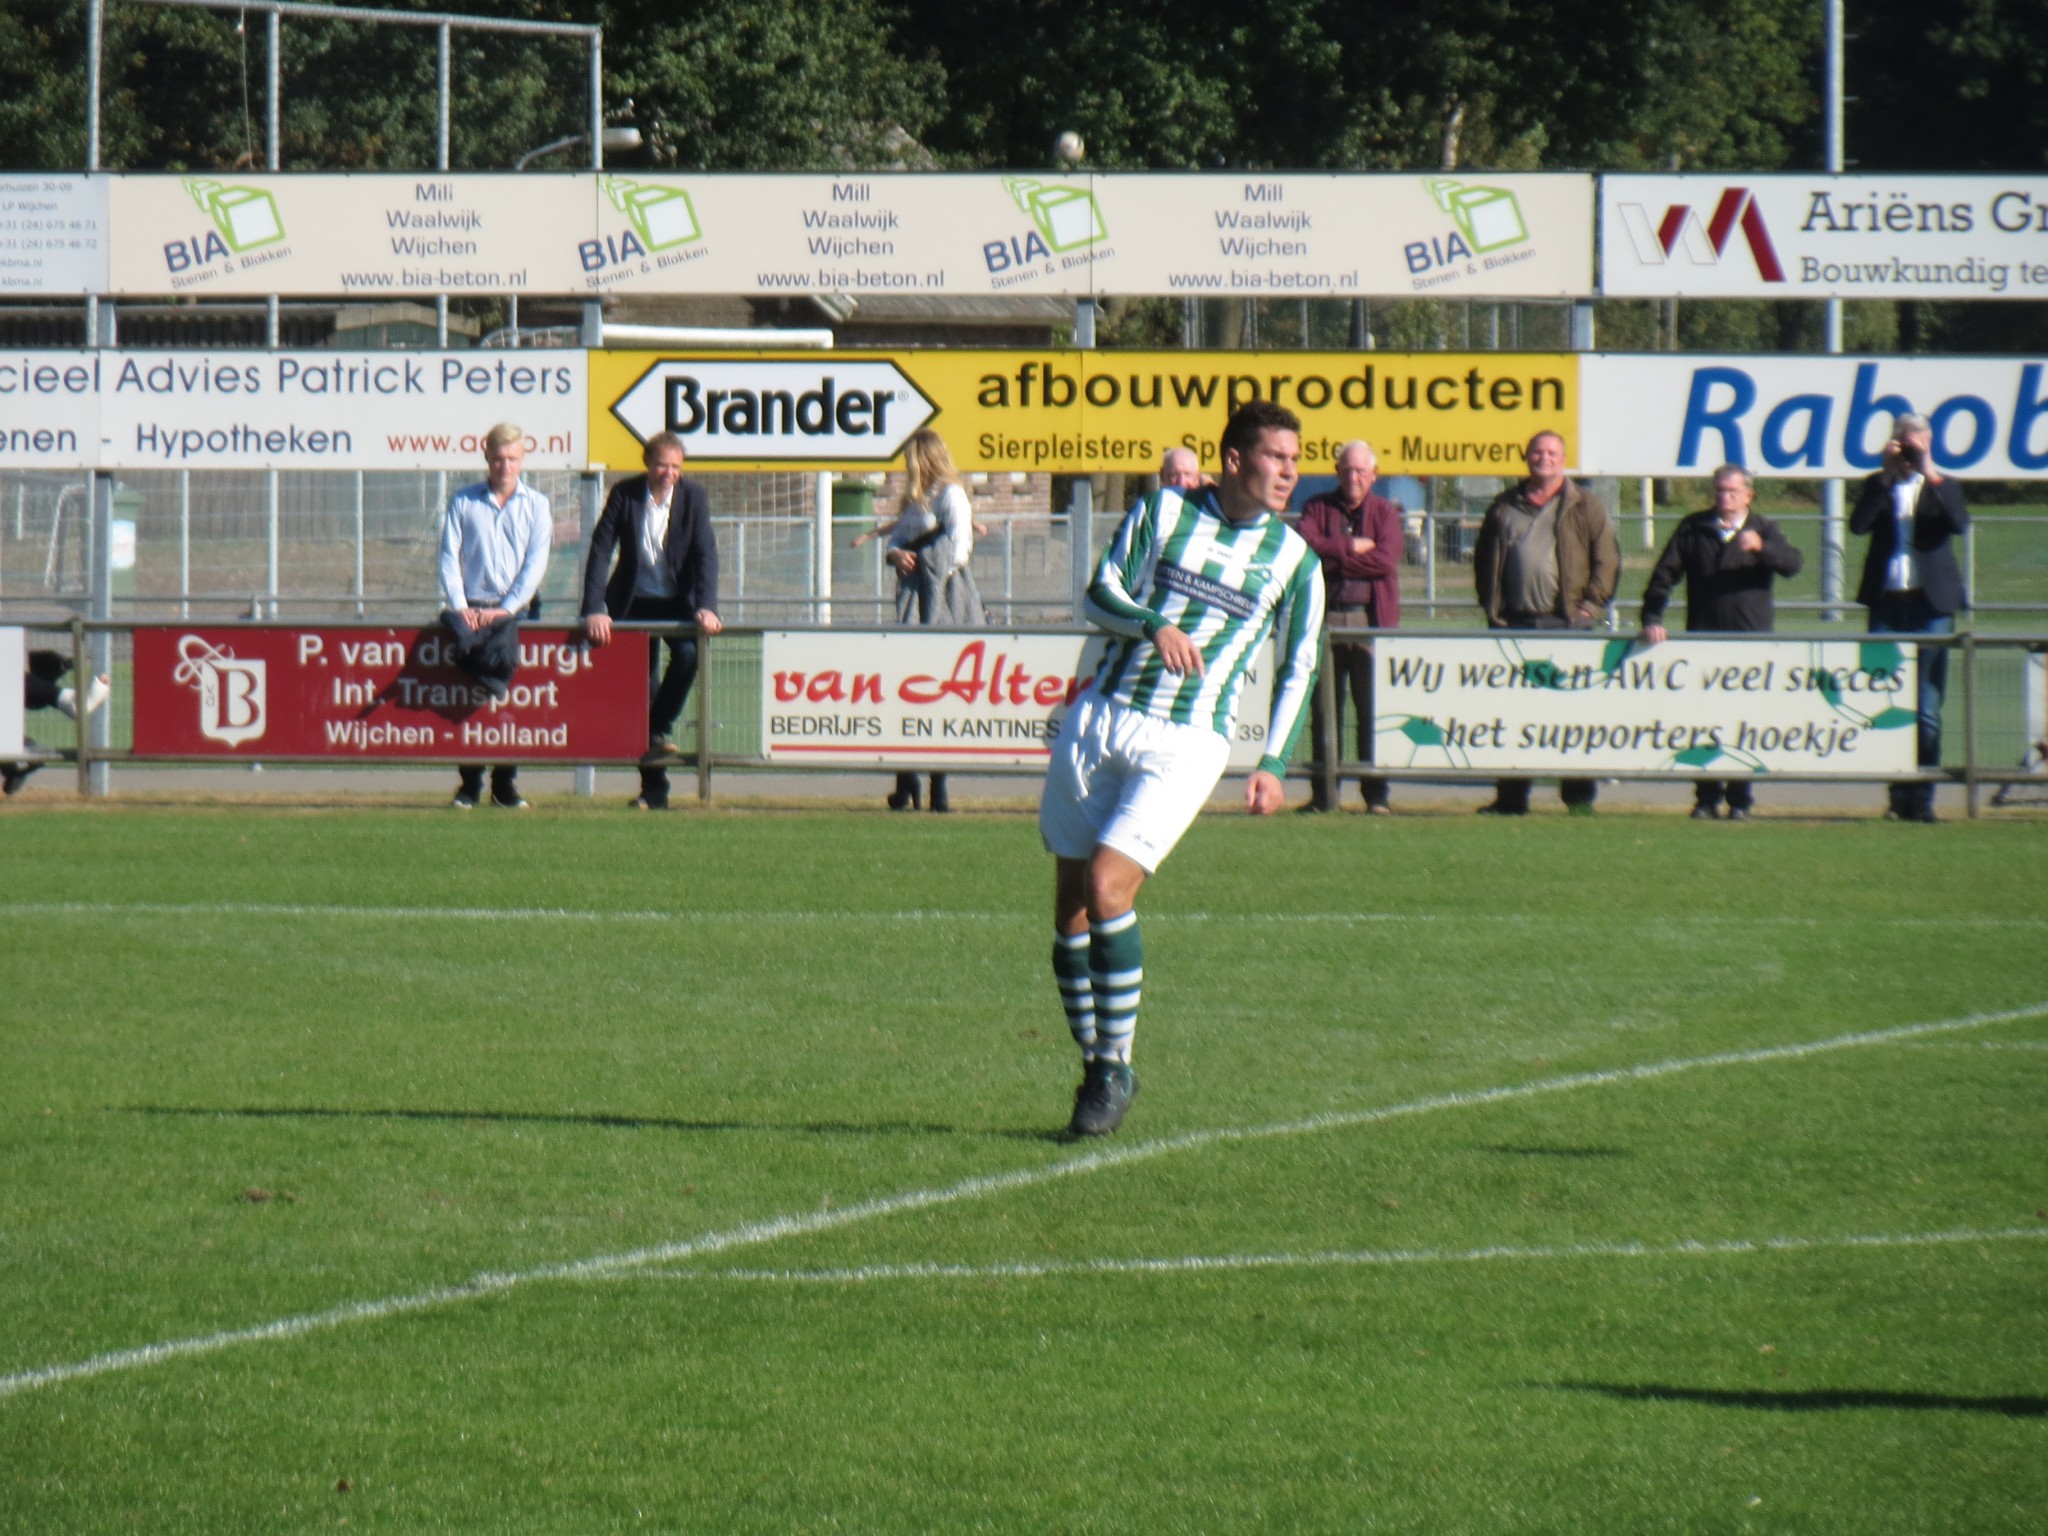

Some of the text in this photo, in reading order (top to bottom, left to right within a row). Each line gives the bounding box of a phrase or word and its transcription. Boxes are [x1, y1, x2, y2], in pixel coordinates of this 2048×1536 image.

[18, 200, 58, 212] Wijchen
[415, 183, 453, 201] Mill
[832, 184, 871, 202] Mill
[1244, 184, 1283, 202] Mill
[21, 219, 43, 231] (24)
[386, 209, 482, 232] Waalwijk
[803, 210, 899, 233] Waalwijk
[1214, 211, 1312, 233] Waalwijk
[1800, 191, 1974, 233] Ariëns
[21, 238, 43, 250] (24)
[164, 230, 229, 273] BIA
[391, 236, 477, 258] Wijchen
[578, 230, 646, 273] BIA
[808, 237, 894, 259] Wijchen
[983, 231, 1051, 273] BIA
[1220, 238, 1307, 259] Wijchen
[1404, 231, 1472, 274] BIA
[171, 245, 293, 289] Stenen & Blokken
[341, 269, 528, 287] www.bia-beton.nl
[585, 245, 709, 289] Stenen & Blokken
[757, 269, 945, 287] www.bia-beton.nl
[991, 246, 1116, 290] Stenen & Blokken
[1169, 270, 1358, 288] www.bia-beton.nl
[1412, 247, 1537, 291] Stenen & Blokken
[1801, 256, 2010, 292] Bouwkundig
[0, 357, 571, 395] cieel Advies Patrick Peters
[977, 361, 1565, 417] afbouwproducten
[665, 375, 896, 436] Brander
[137, 423, 352, 459] Hypotheken
[979, 432, 1152, 466] Sierpleisters
[299, 634, 593, 675] P. van de urgt
[773, 670, 885, 703] van
[1389, 656, 1445, 694] Wij
[1459, 662, 1592, 690] wensen
[1703, 661, 1774, 692] veel
[1784, 665, 1906, 692] succes
[333, 677, 559, 712] Int. Transport
[325, 720, 434, 750] Wijchen
[463, 721, 568, 747] Holland
[771, 714, 882, 736] BEDRIJFS
[902, 718, 933, 737] EN
[1518, 719, 1724, 755] supporters
